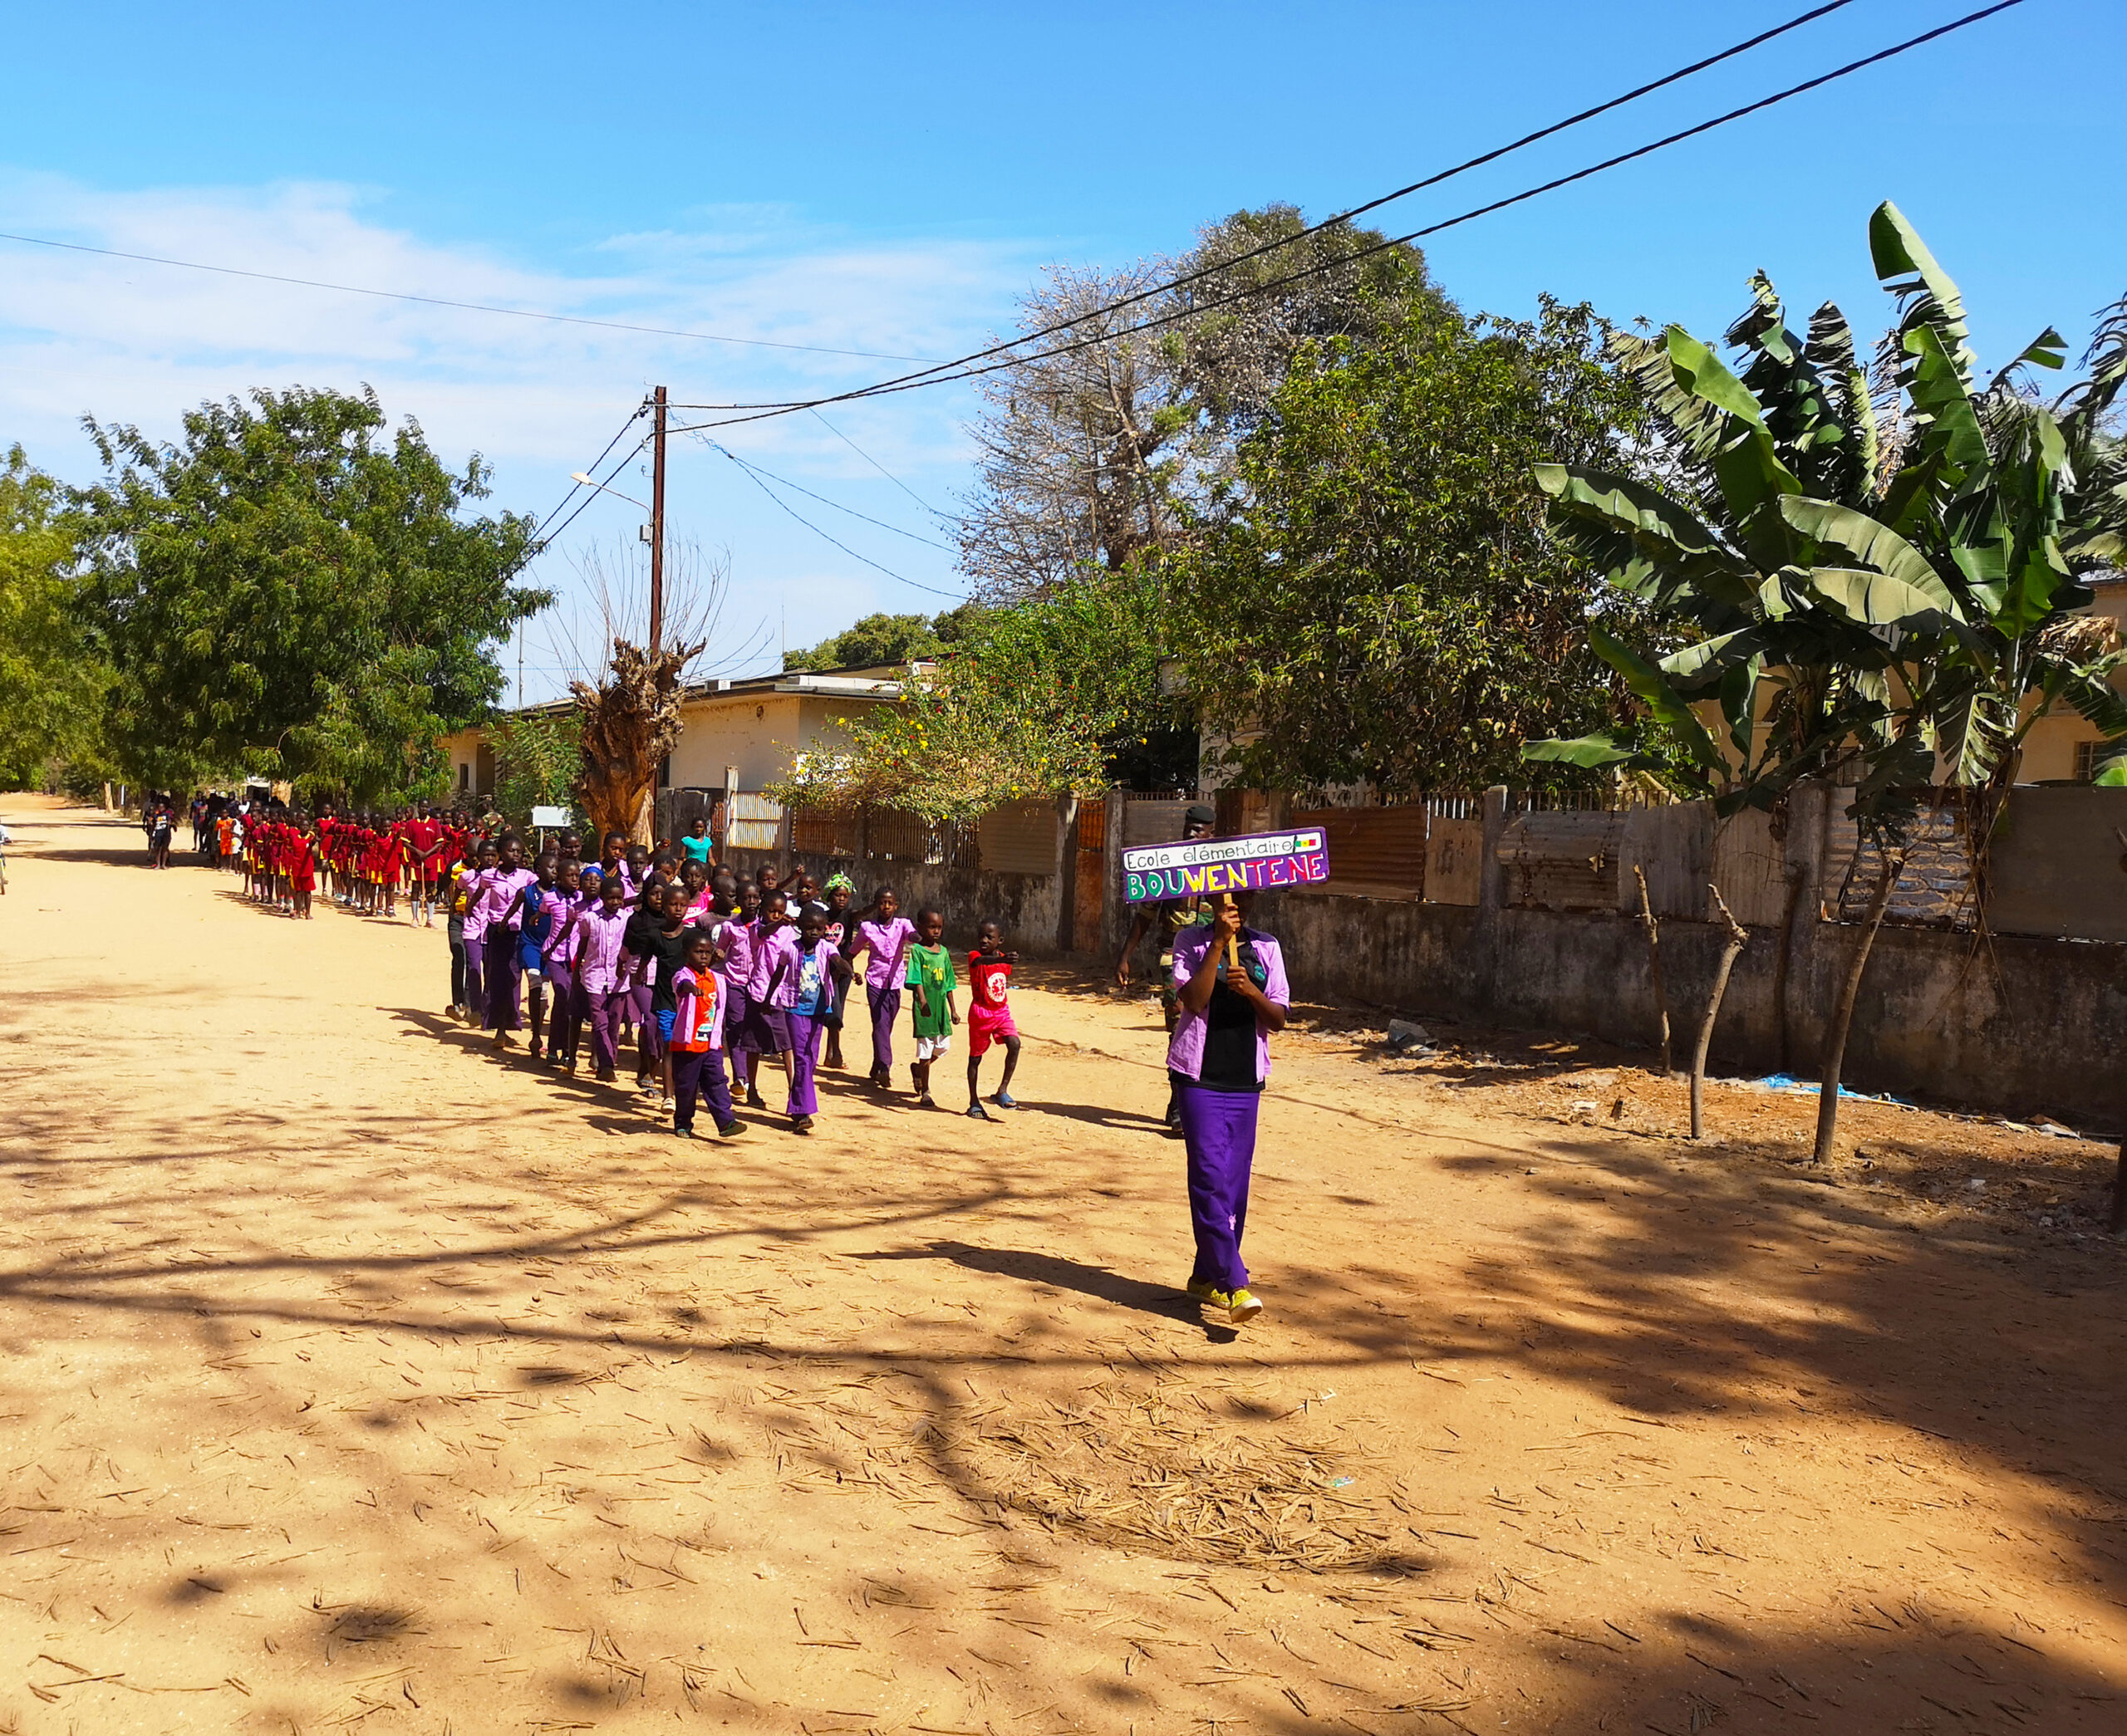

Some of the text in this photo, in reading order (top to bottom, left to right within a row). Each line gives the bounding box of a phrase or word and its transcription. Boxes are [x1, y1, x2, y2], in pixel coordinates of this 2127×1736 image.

[1127, 841, 1293, 870] Ecole élémentaire
[1127, 853, 1326, 900] BOUWENTENE
